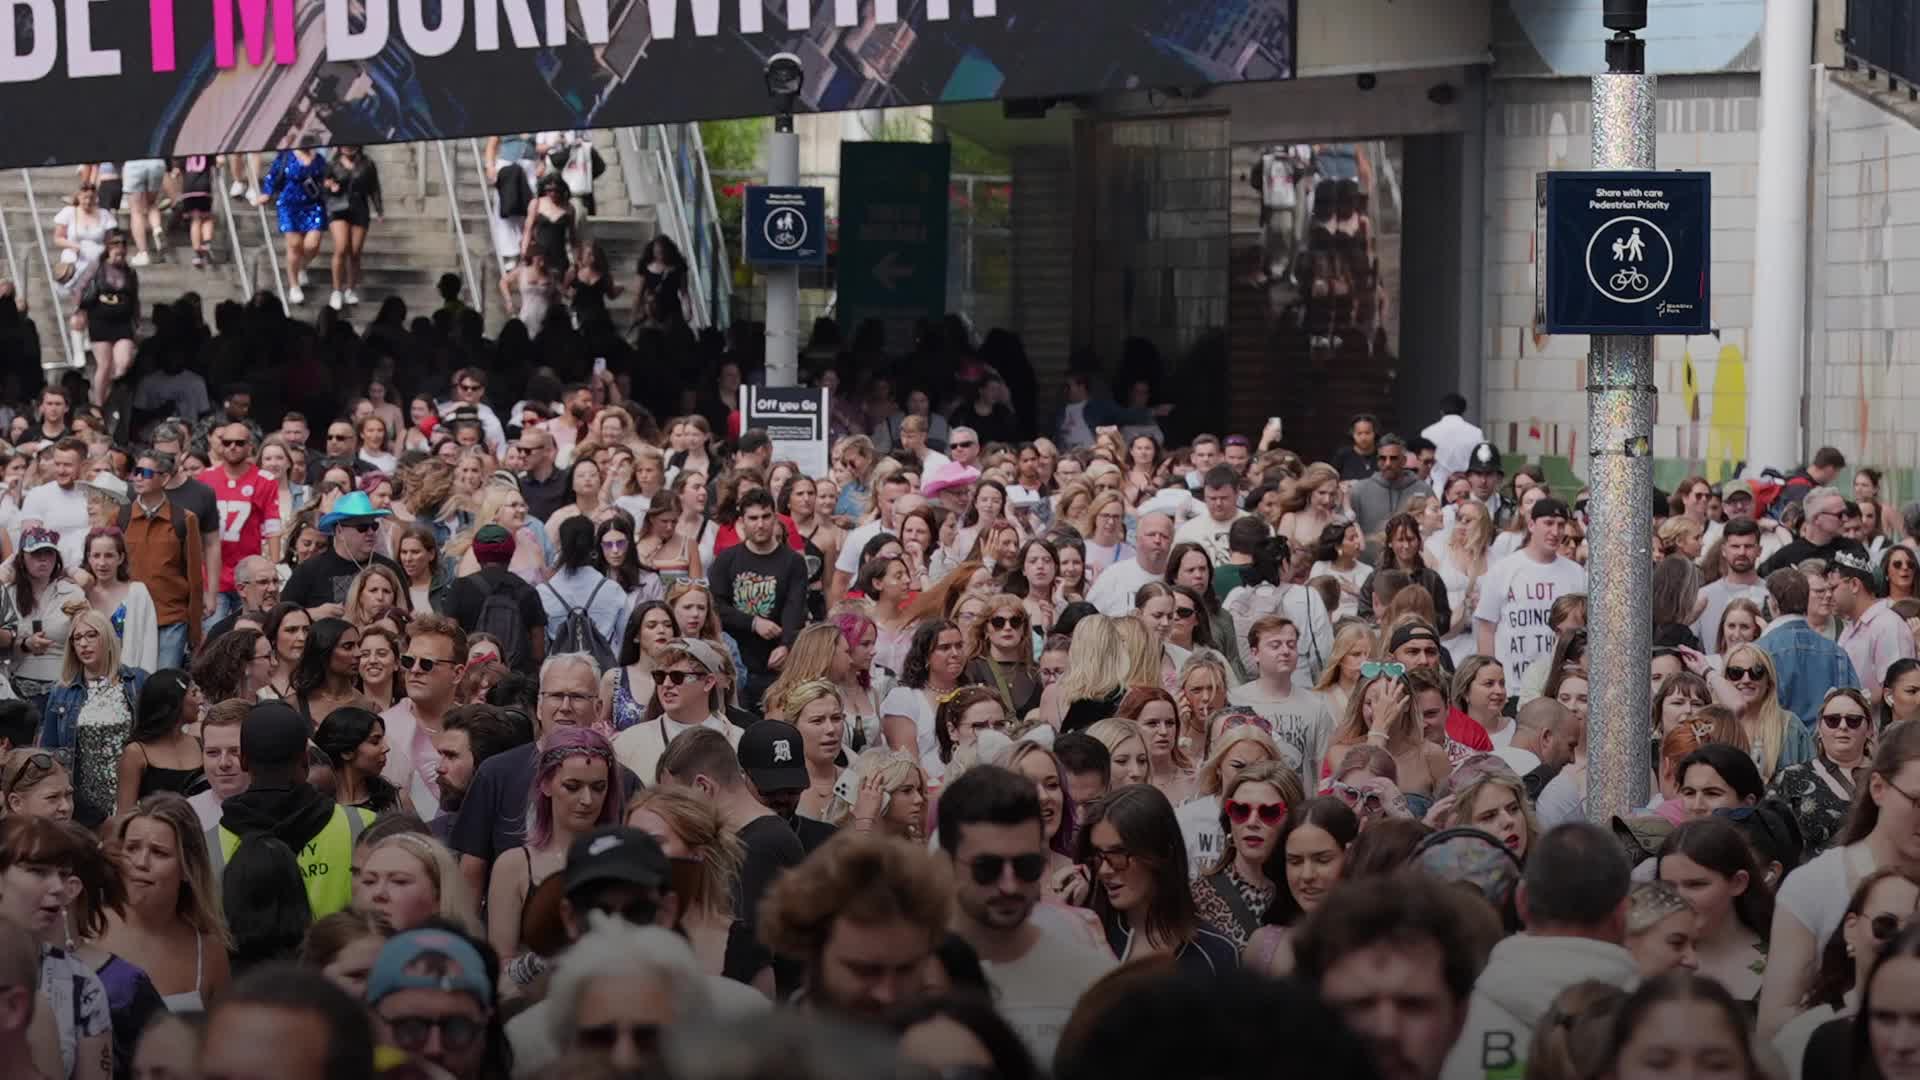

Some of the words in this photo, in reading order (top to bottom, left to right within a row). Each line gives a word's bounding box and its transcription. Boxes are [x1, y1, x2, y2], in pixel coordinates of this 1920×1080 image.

[1595, 188, 1621, 198] Share
[1622, 188, 1643, 198] with
[1643, 190, 1664, 198] care
[1589, 200, 1636, 210] Pedestrian
[1637, 200, 1670, 211] Priority
[757, 399, 778, 411] Off
[779, 401, 800, 412] you
[1507, 586, 1516, 602] A
[1526, 583, 1555, 600] LOT
[1511, 635, 1526, 654] AT
[1534, 634, 1555, 653] TH
